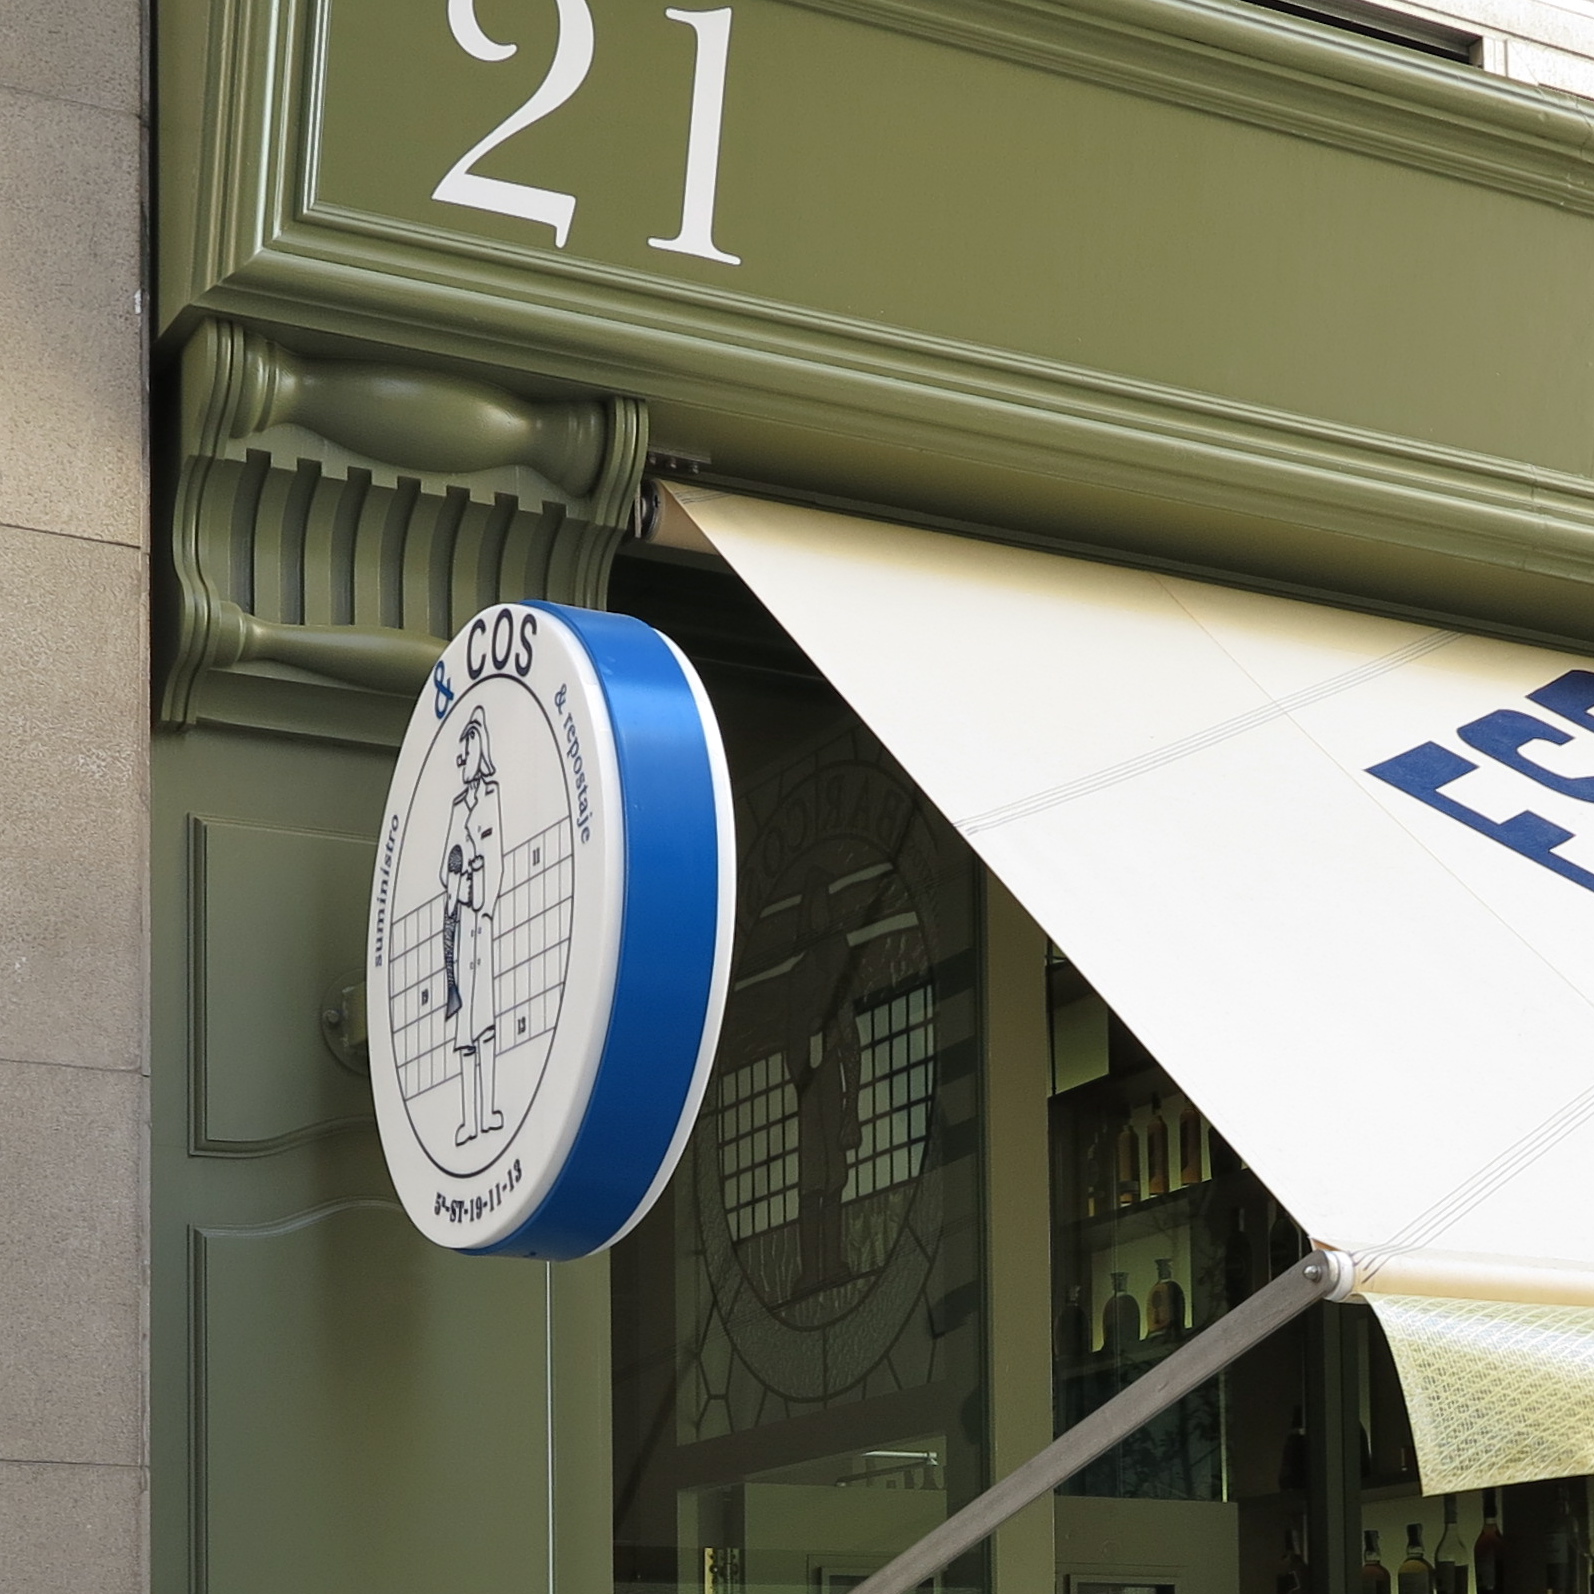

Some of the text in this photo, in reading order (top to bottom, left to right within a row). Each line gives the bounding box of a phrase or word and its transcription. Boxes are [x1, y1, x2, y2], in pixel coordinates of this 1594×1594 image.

[431, 0, 742, 265] 21
[434, 608, 538, 719] & COS
[555, 683, 594, 845] & repostaje
[375, 814, 399, 967] suministro
